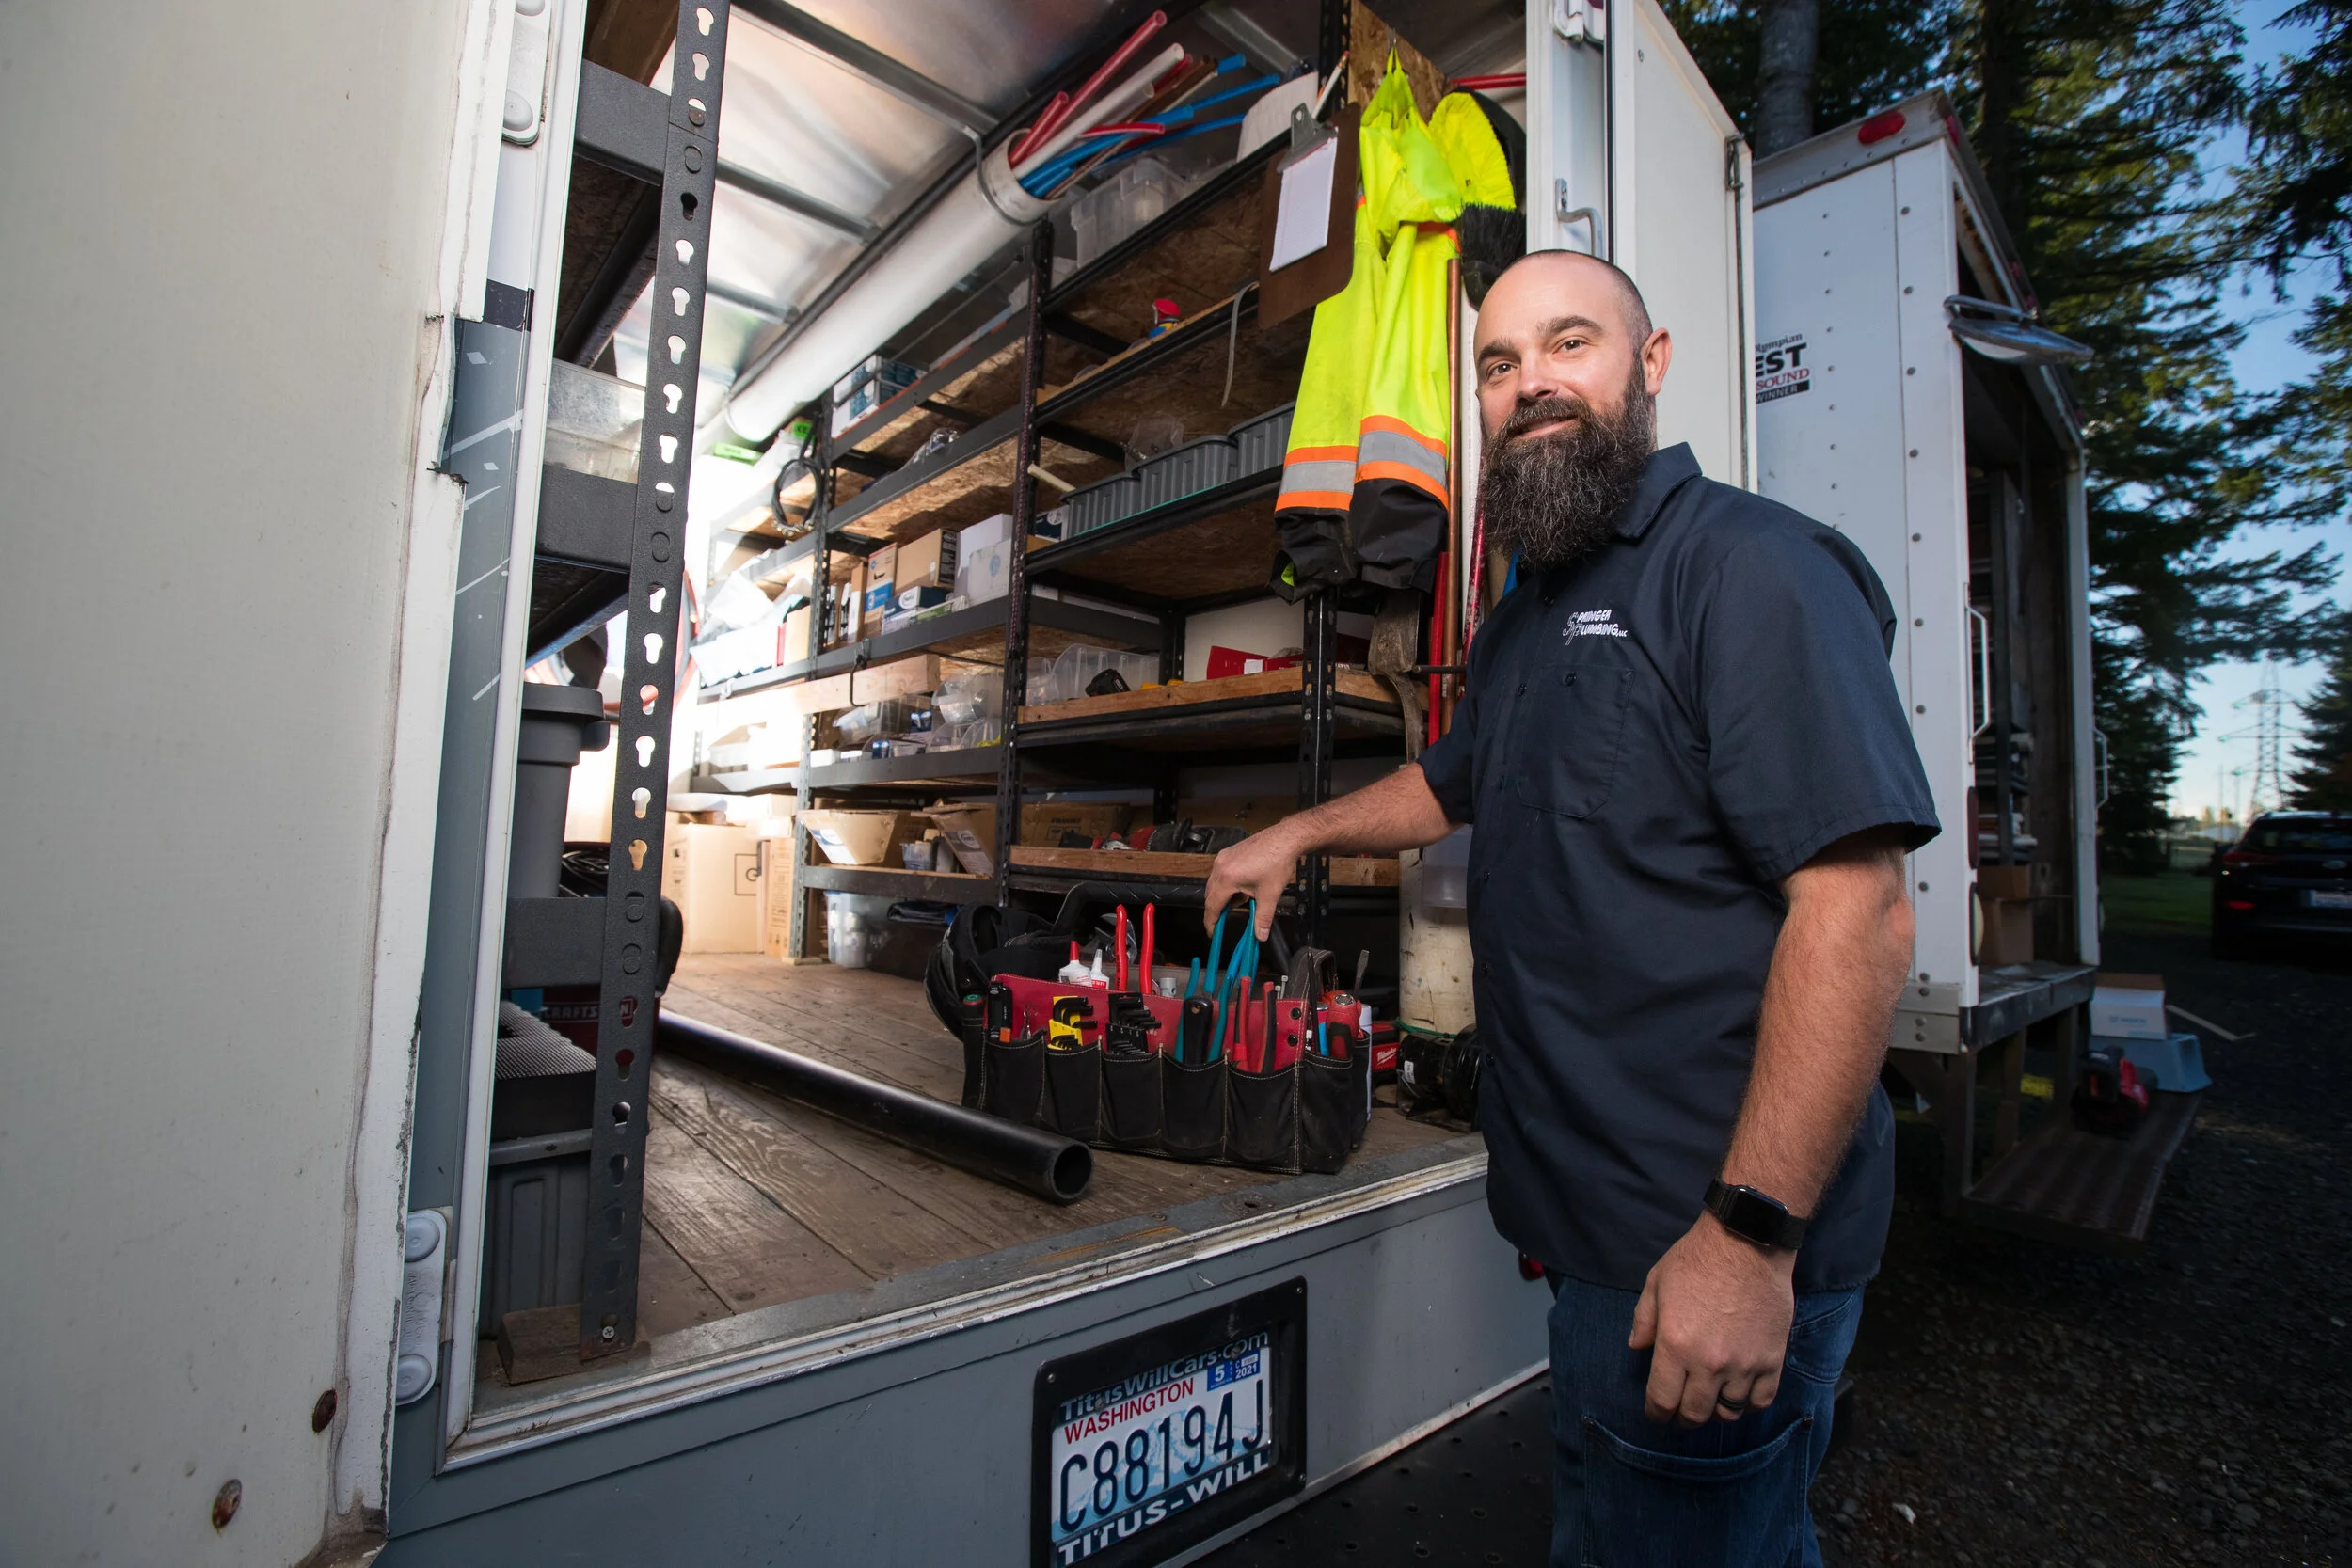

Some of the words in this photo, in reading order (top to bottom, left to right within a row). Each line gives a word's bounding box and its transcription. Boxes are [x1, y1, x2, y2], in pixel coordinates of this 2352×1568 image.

[1756, 334, 1803, 353] lympian
[1756, 342, 1807, 378] EST
[1756, 368, 1810, 390] SOUND
[1756, 384, 1798, 403] WINNER
[544, 1004, 629, 1019] CRAFTSN
[1215, 1365, 1225, 1382] 5
[1235, 1363, 1257, 1379] 2021
[1064, 1377, 1195, 1445] WASHINGTON
[1060, 1379, 1263, 1534] C88194J
[1058, 1454, 1269, 1566] TITUS-WILL
